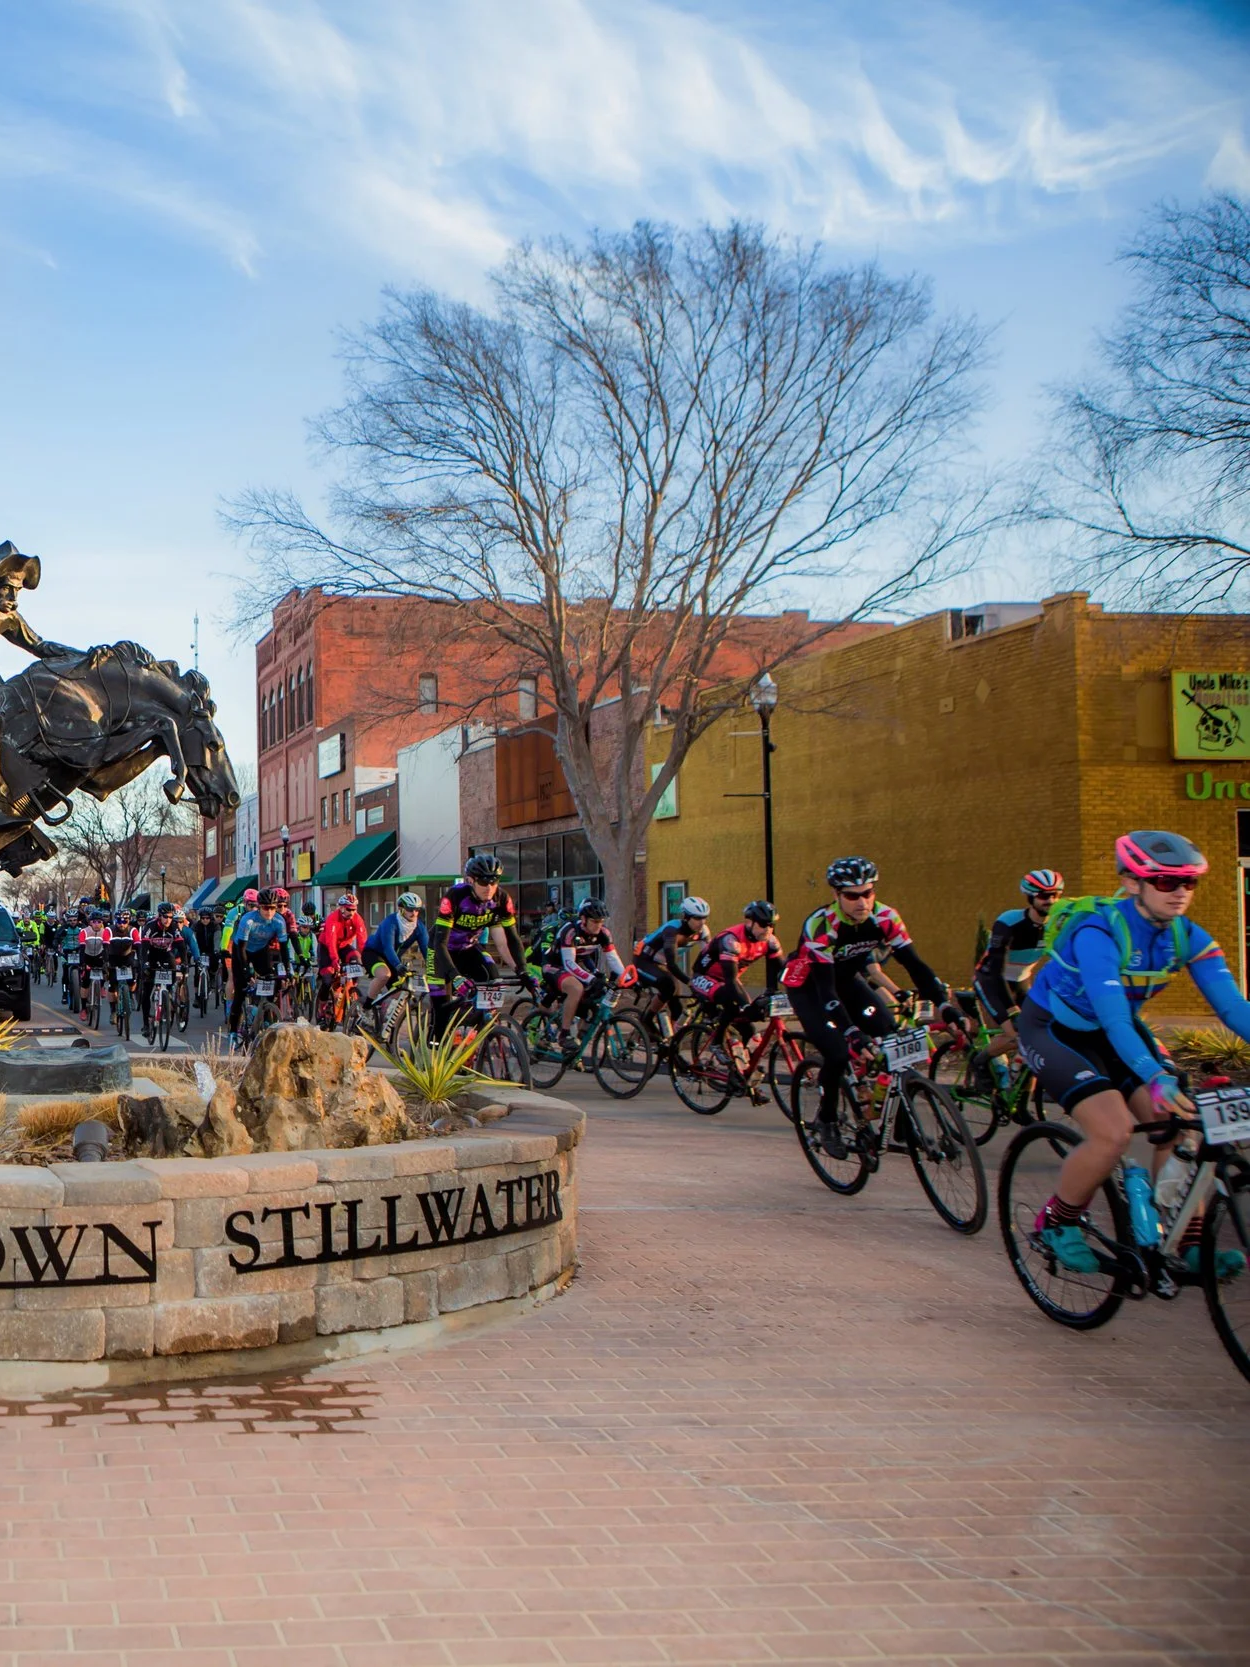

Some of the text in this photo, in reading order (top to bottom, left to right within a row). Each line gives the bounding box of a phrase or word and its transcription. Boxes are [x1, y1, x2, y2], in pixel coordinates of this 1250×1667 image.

[1189, 673, 1215, 690] Uncle
[894, 1041, 921, 1058] 1180
[224, 1168, 563, 1275] STILLWATER
